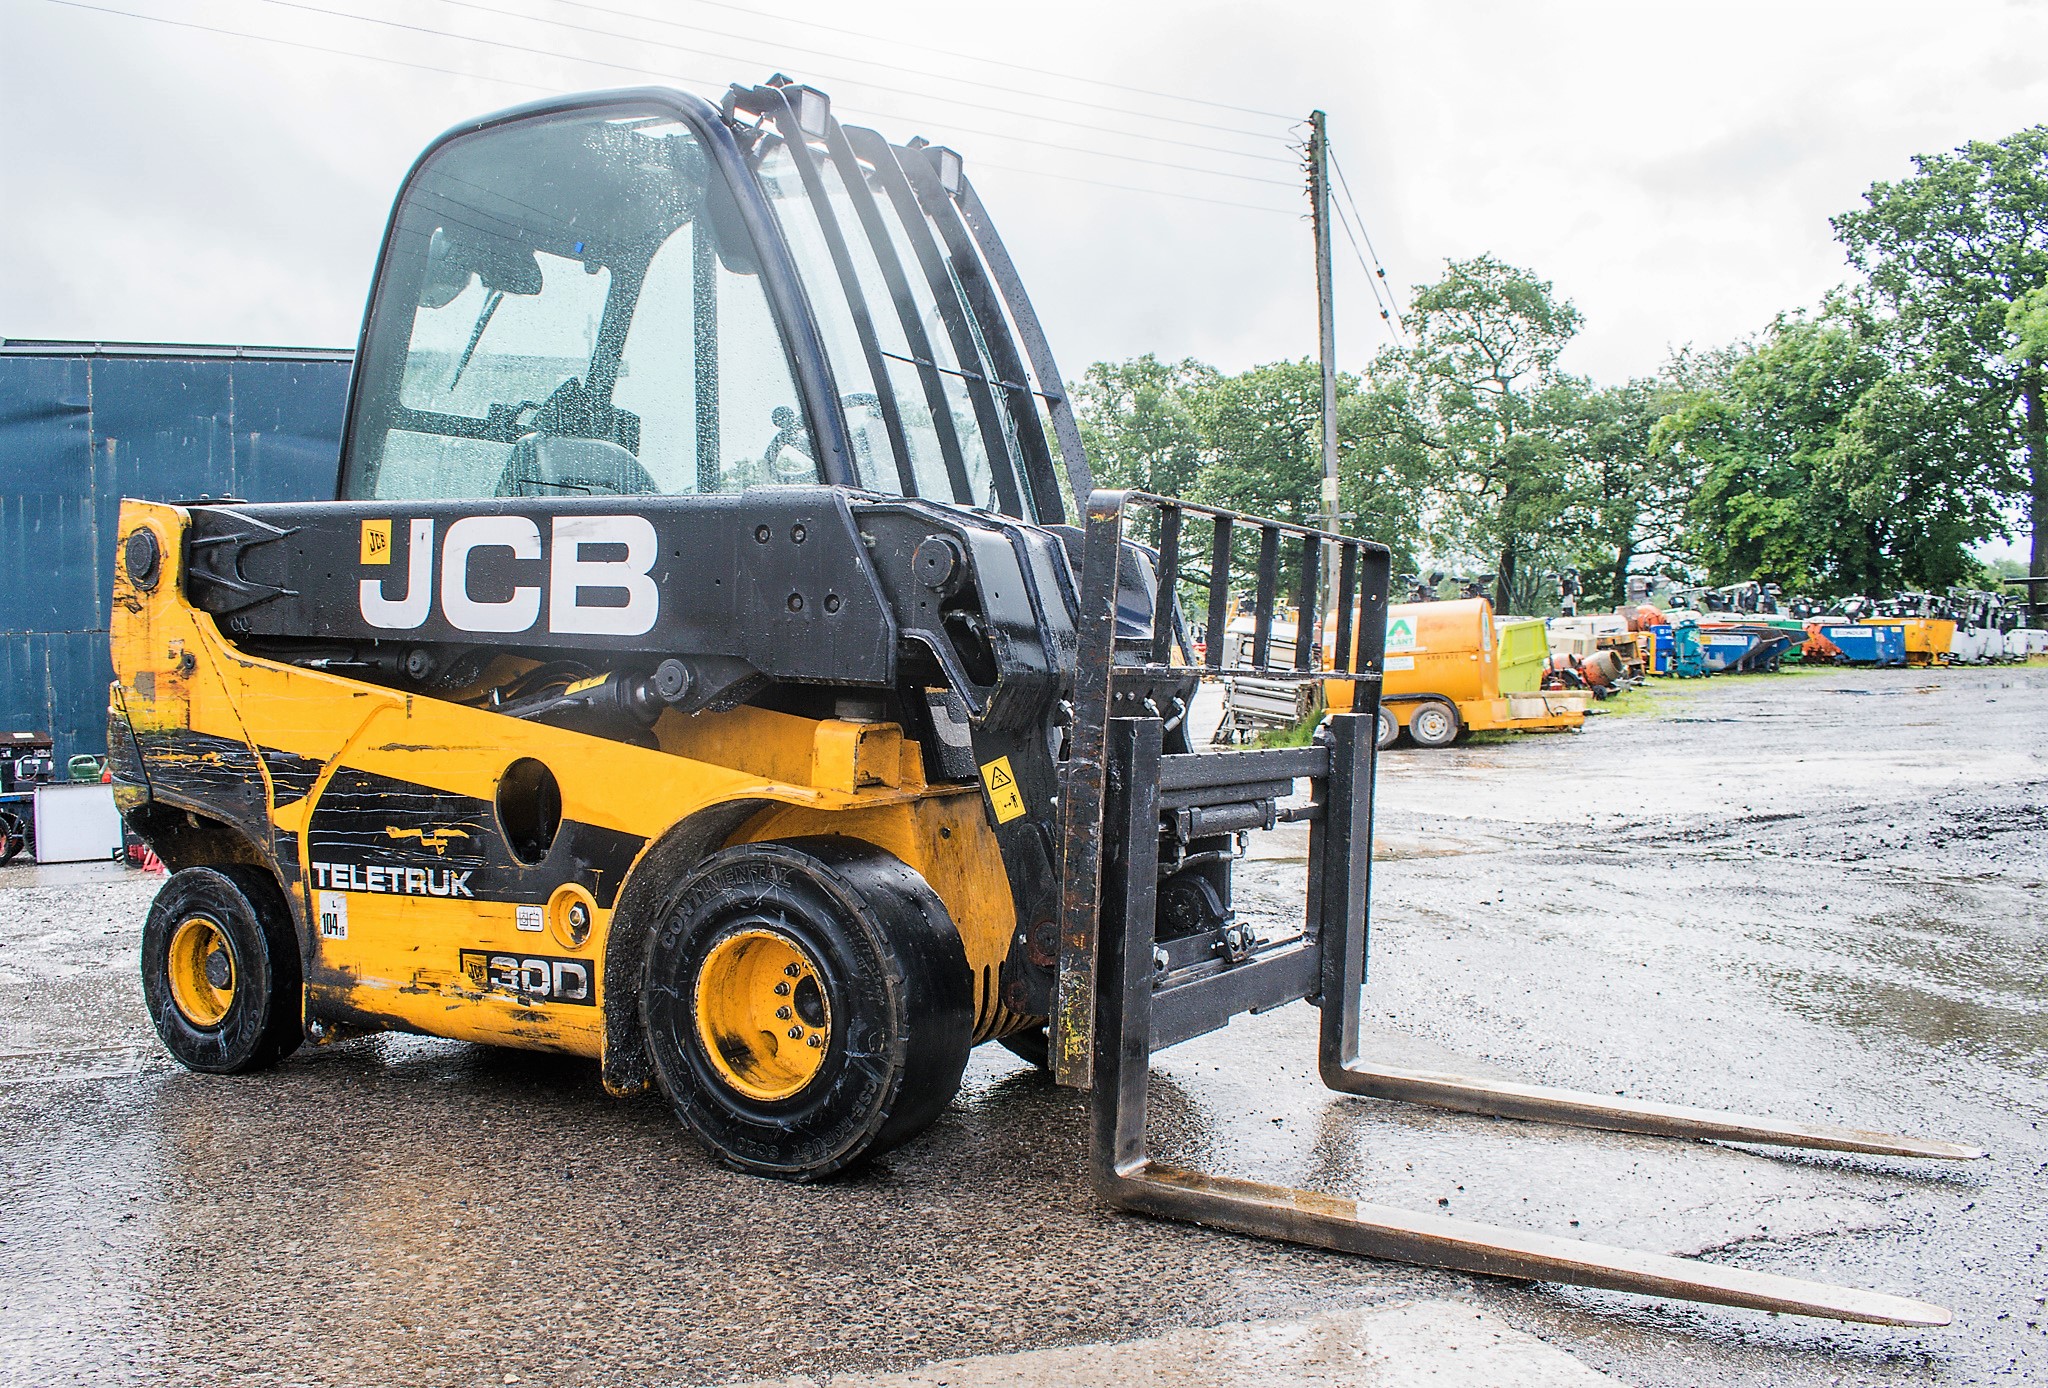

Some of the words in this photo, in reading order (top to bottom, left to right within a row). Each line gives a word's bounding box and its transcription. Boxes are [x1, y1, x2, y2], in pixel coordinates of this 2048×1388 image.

[369, 528, 387, 555] JCB
[359, 515, 660, 636] JCB
[1386, 637, 1415, 646] PLANT
[312, 861, 475, 898] TELETRUK
[332, 900, 337, 908] L
[662, 863, 795, 950] CONTINENTAL
[322, 912, 339, 936] 104
[468, 962, 484, 980] JCB
[490, 956, 588, 1000] 30D
[736, 1136, 780, 1159] SC20
